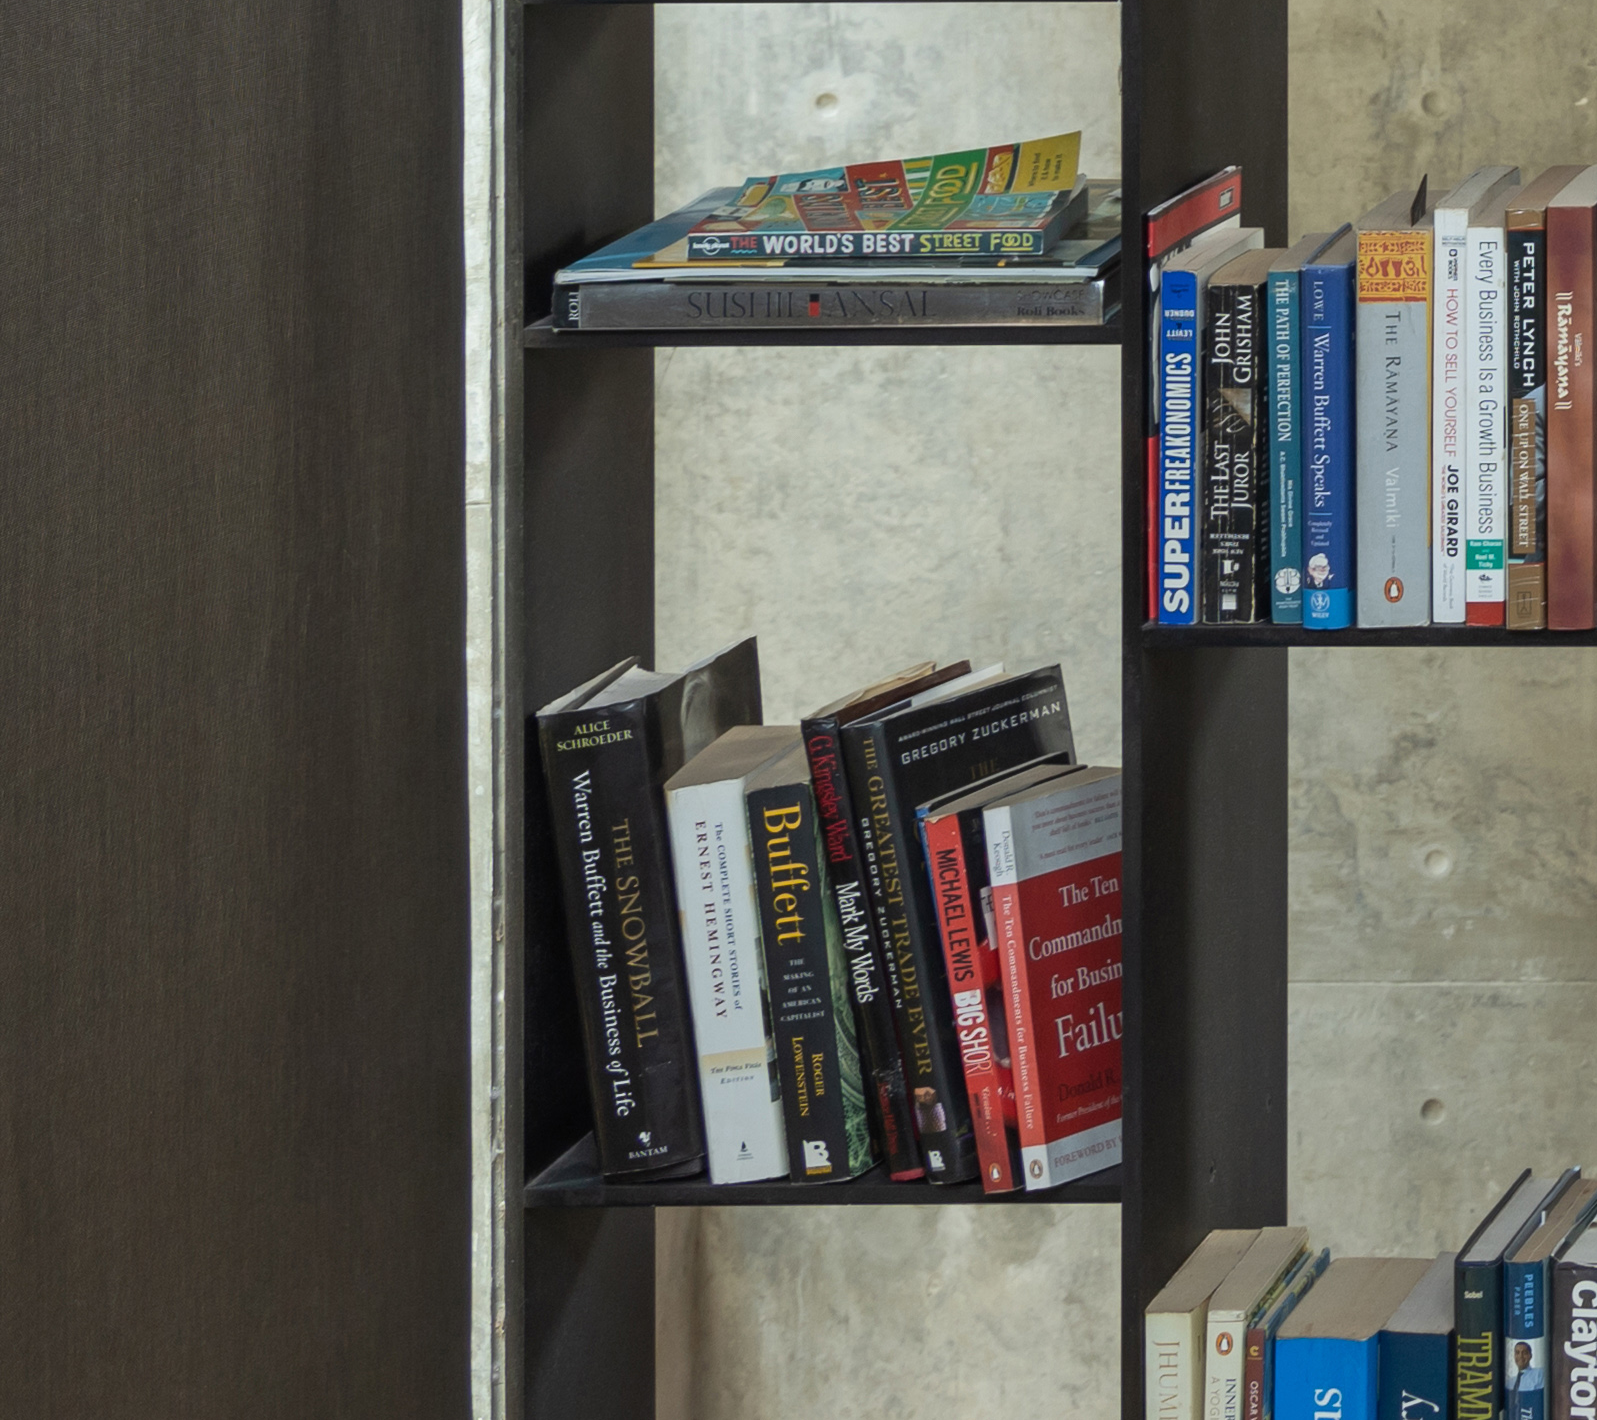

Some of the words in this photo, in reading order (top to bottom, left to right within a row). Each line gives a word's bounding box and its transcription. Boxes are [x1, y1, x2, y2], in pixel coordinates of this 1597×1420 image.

[730, 236, 758, 250] THE
[763, 234, 854, 254] WORLD'S
[862, 233, 914, 253] BEST
[920, 232, 981, 251] STREET
[990, 232, 1034, 251] FOOD
[1523, 242, 1535, 309] PETER
[1213, 312, 1231, 364] JOHN
[1234, 295, 1252, 384] GRISHAM
[1313, 333, 1330, 390] Warren
[1523, 316, 1535, 388] LYNCH
[1313, 395, 1331, 451] Buffett
[1310, 454, 1332, 508] Speaks
[556, 729, 633, 752] SCHROEDER
[574, 721, 611, 736] ALICE
[901, 734, 966, 765] GREGORY
[972, 701, 1062, 741] ZUCKERMAN
[612, 818, 634, 866] THE
[696, 821, 713, 891] ERNEST
[763, 802, 812, 946] Buffett
[936, 848, 966, 927] MICHAEL
[616, 874, 659, 1048] SNOWBALL
[704, 902, 728, 1019] HEMINGWAY
[948, 928, 974, 983] LEWIS
[1524, 1274, 1534, 1329] PEEBLES
